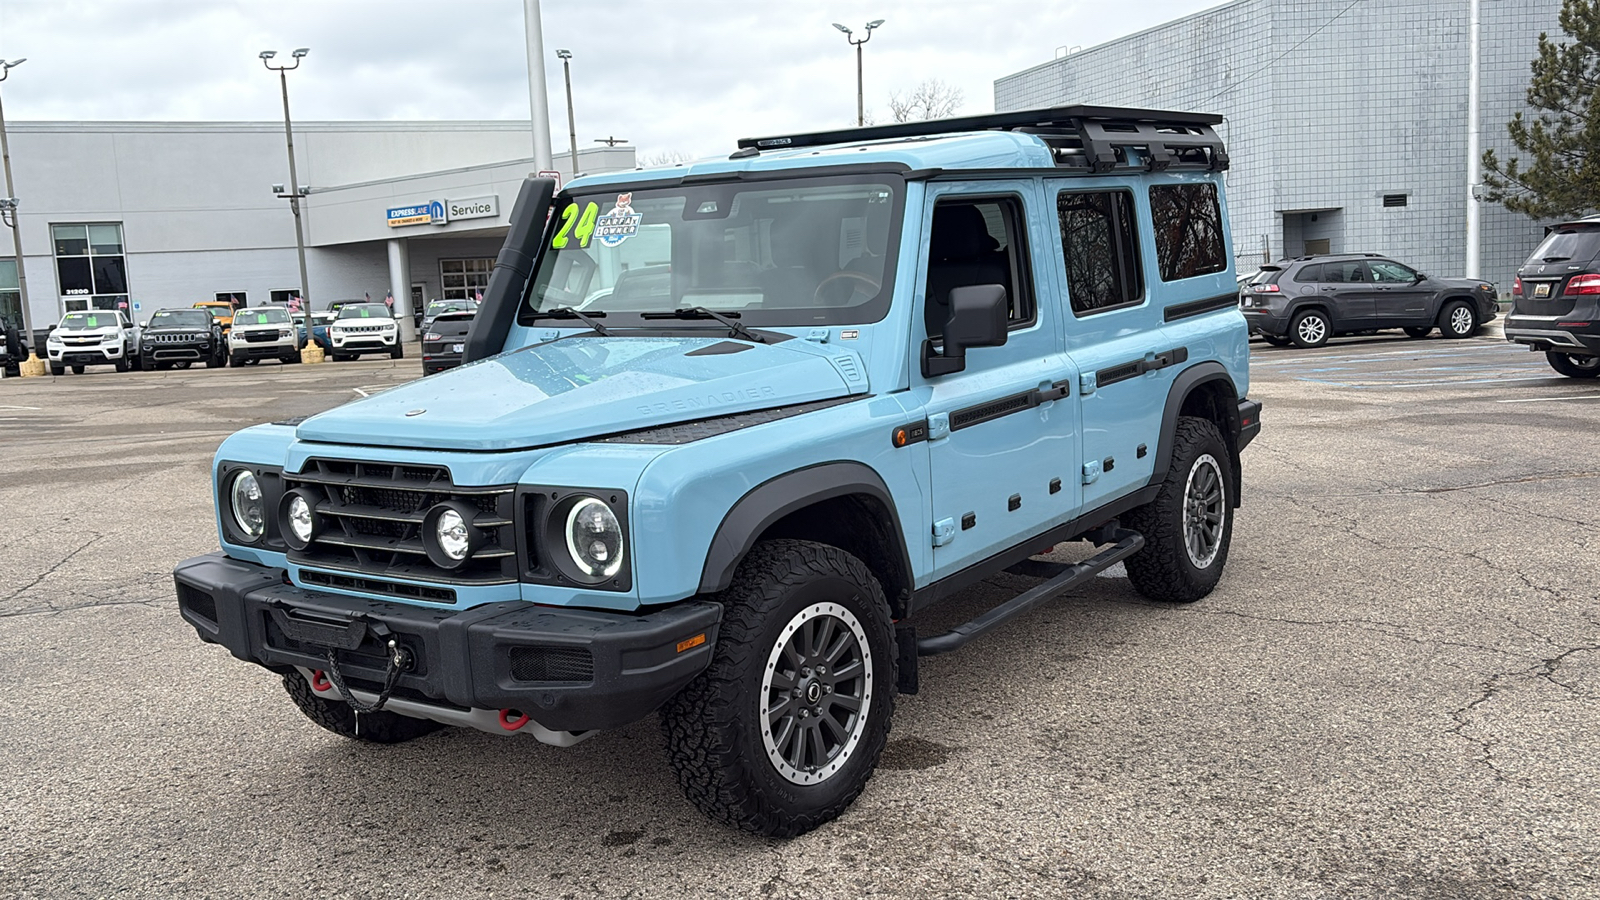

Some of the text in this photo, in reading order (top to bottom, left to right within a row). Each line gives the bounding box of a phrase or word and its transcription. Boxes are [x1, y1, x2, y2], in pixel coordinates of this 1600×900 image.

[451, 203, 491, 216] Service
[552, 202, 599, 249] 24
[599, 217, 637, 226] CARFAX
[603, 226, 636, 235] OWNER
[636, 385, 776, 415] GRENADIER
